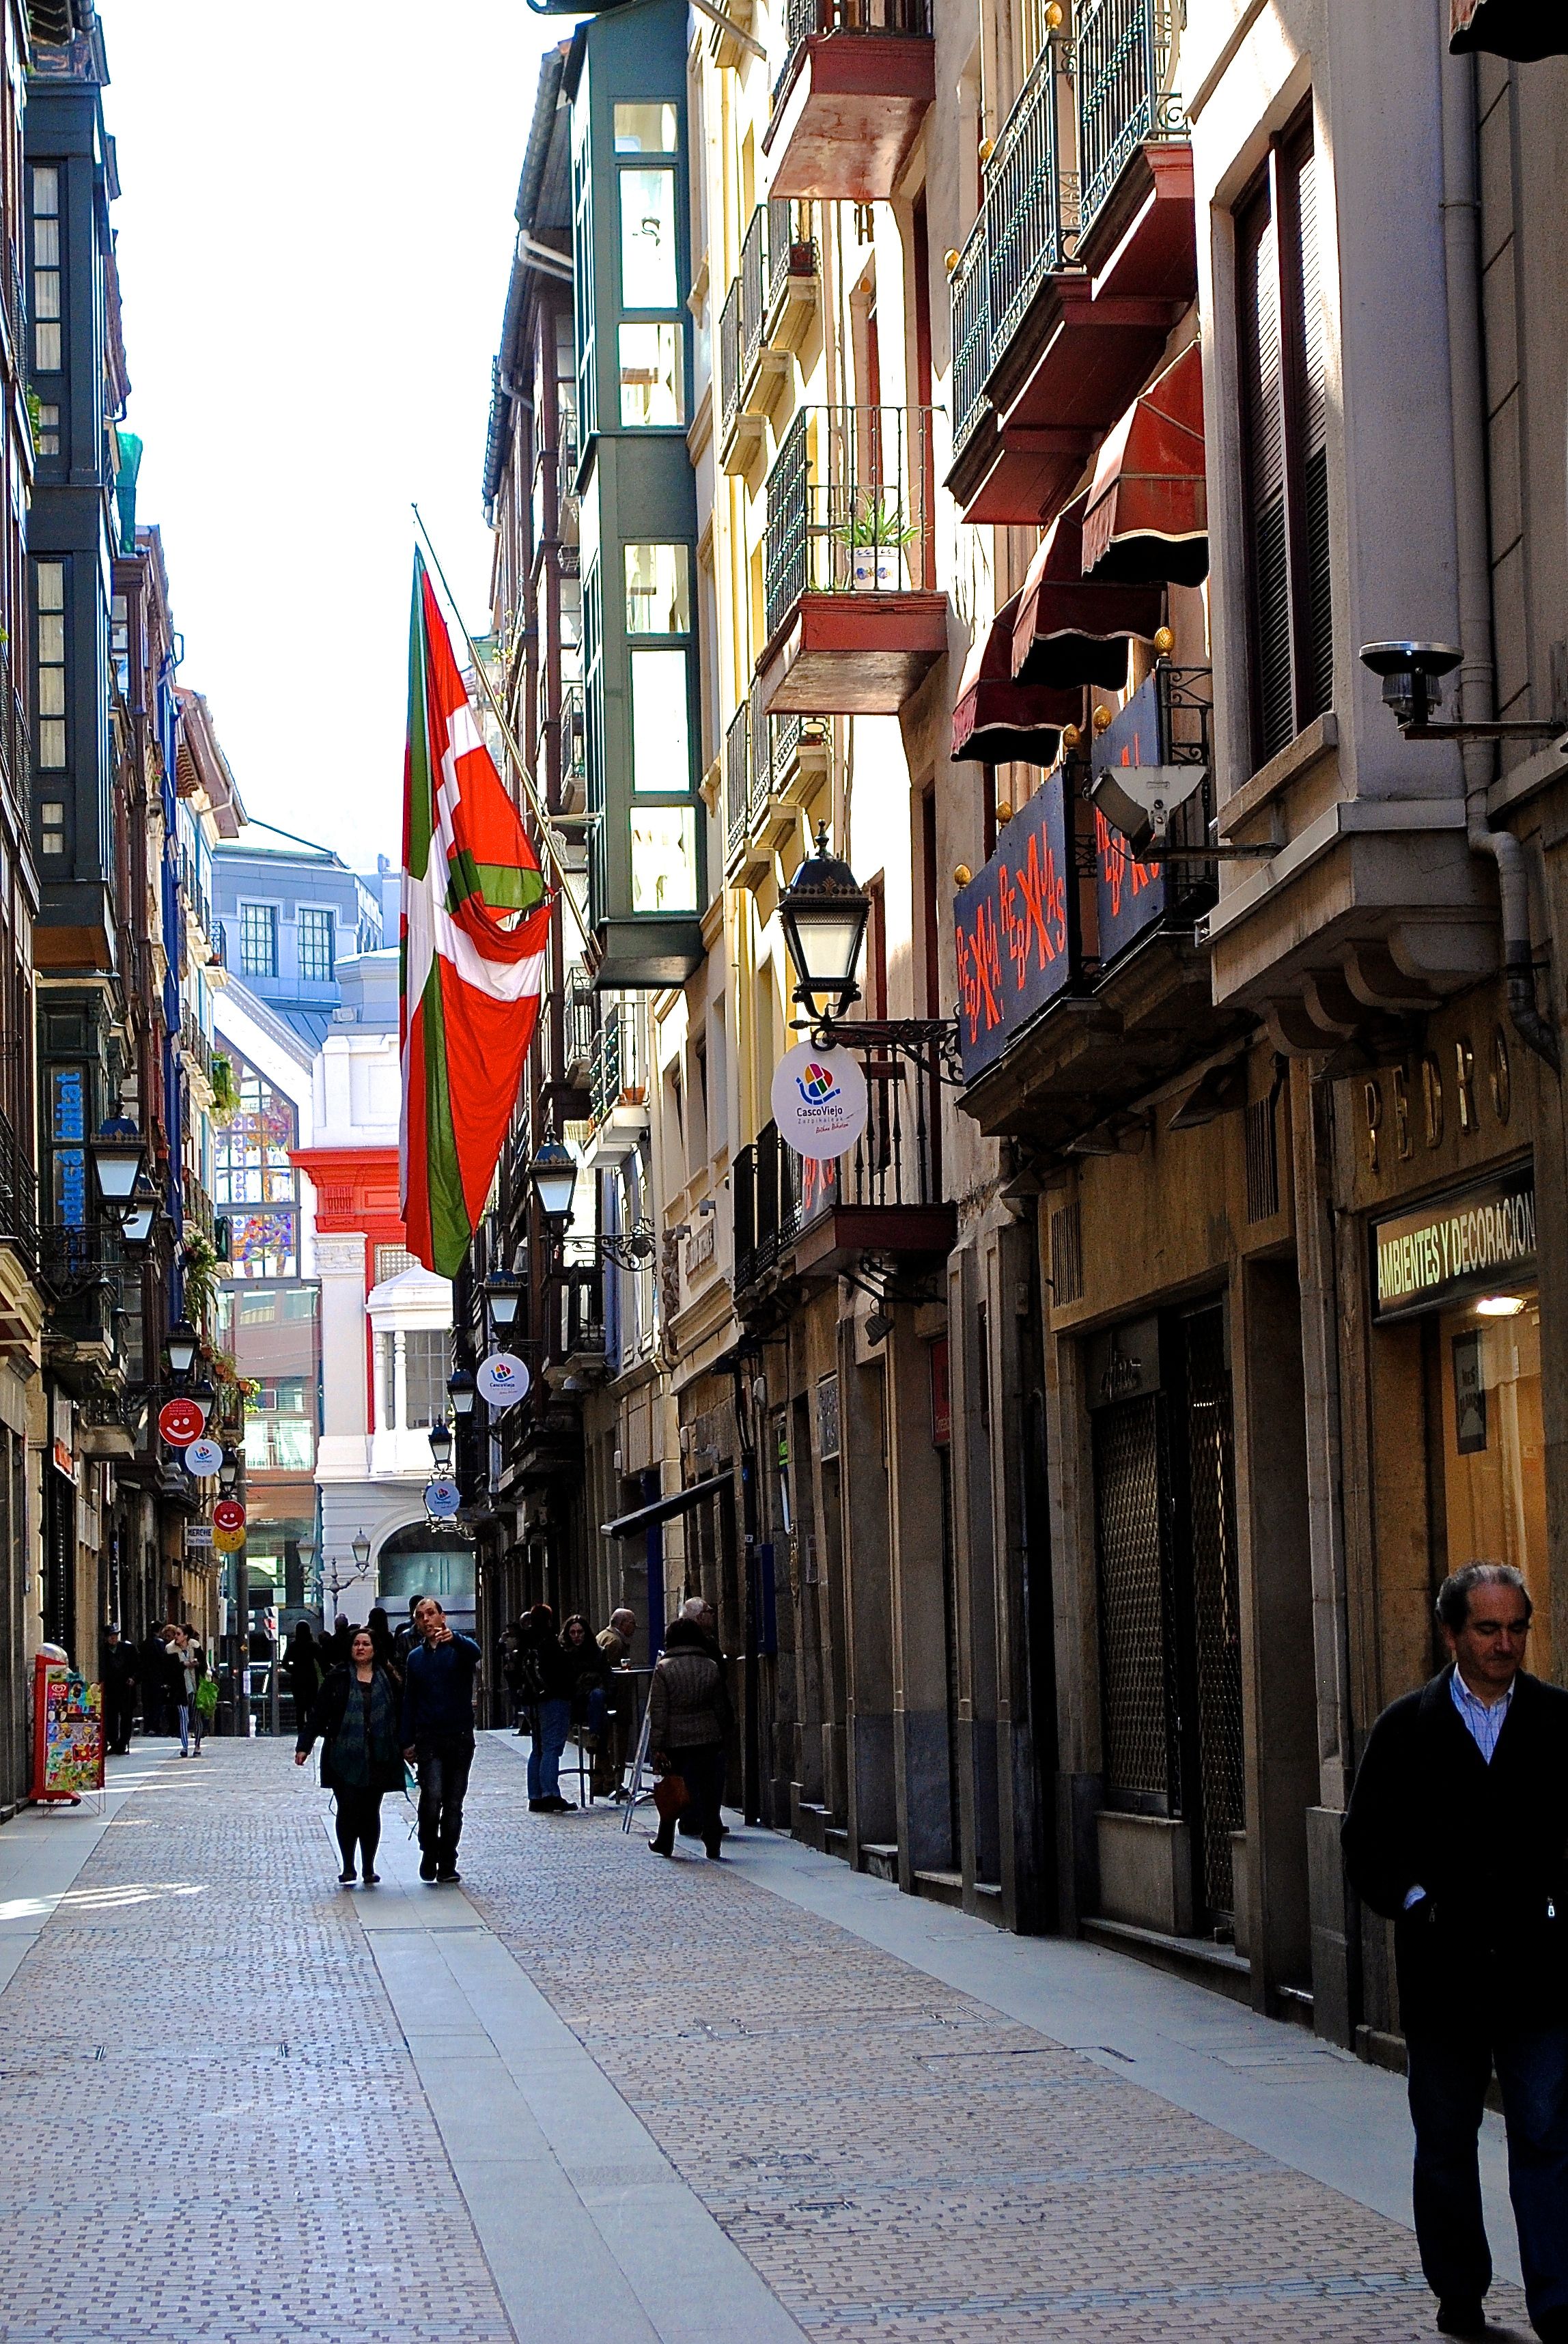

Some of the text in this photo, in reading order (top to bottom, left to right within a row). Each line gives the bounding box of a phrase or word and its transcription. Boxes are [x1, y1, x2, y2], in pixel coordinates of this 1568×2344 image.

[797, 1106, 843, 1117] CascoViejo
[1364, 1023, 1511, 1173] PEDRO
[1378, 1190, 1537, 1300] AMBIENTES Y DECORACION
